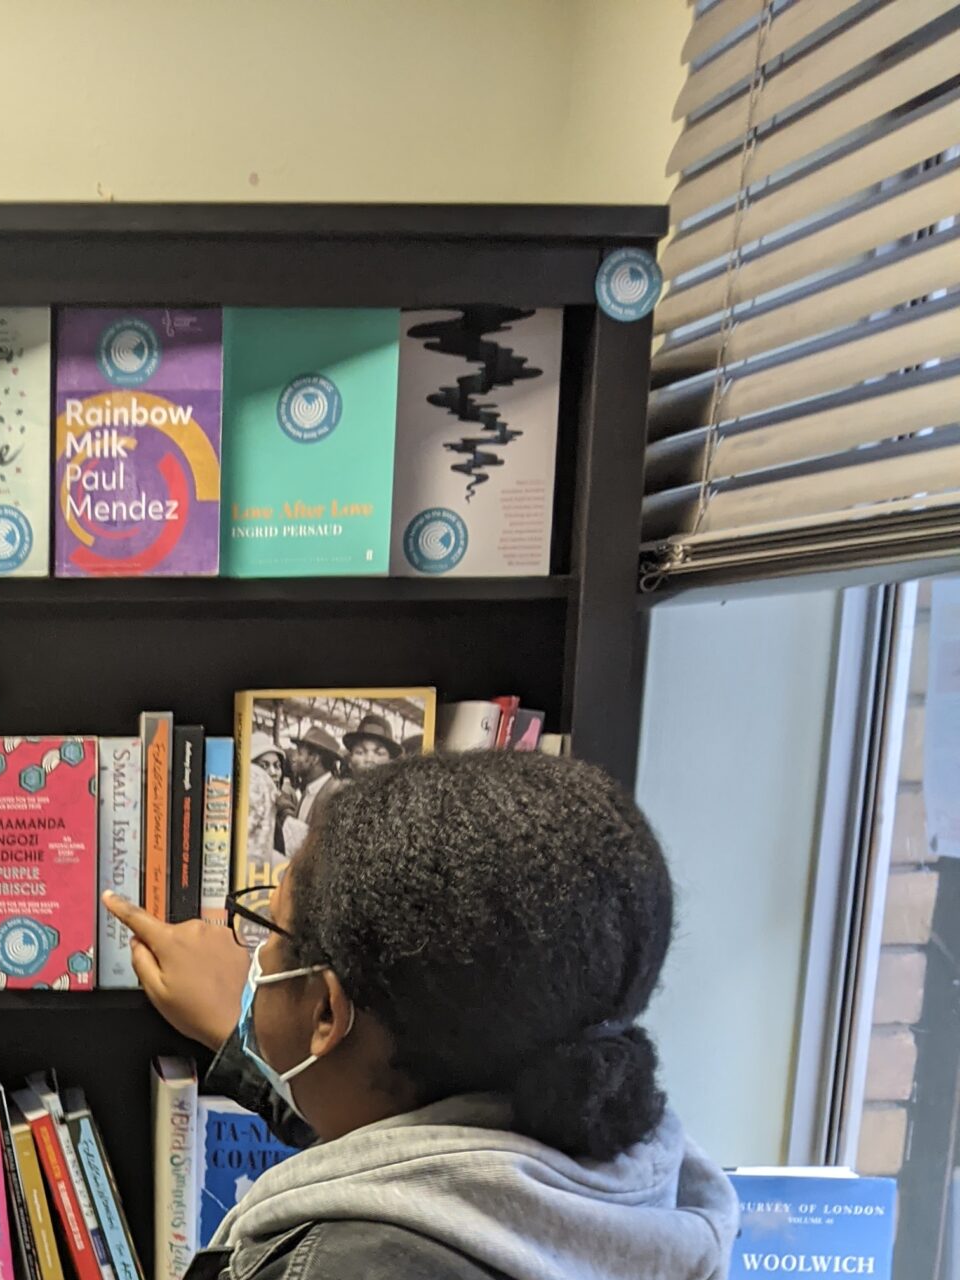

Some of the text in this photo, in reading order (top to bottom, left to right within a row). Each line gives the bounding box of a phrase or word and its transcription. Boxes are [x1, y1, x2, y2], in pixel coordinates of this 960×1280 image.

[66, 397, 193, 427] Rainbow
[66, 430, 127, 459] Milk
[66, 462, 124, 490] Paul
[65, 492, 179, 521] Mendez
[231, 499, 374, 521] Love After Love
[231, 523, 343, 538] INGRID PERSAUD
[112, 750, 131, 887] SMALL ISLAND
[203, 773, 231, 897] ZADIE SMITH
[170, 1113, 194, 1152] Bird
[740, 1201, 886, 1217] SURVEY OF LONDON
[742, 1253, 876, 1274] WOOLWICH
